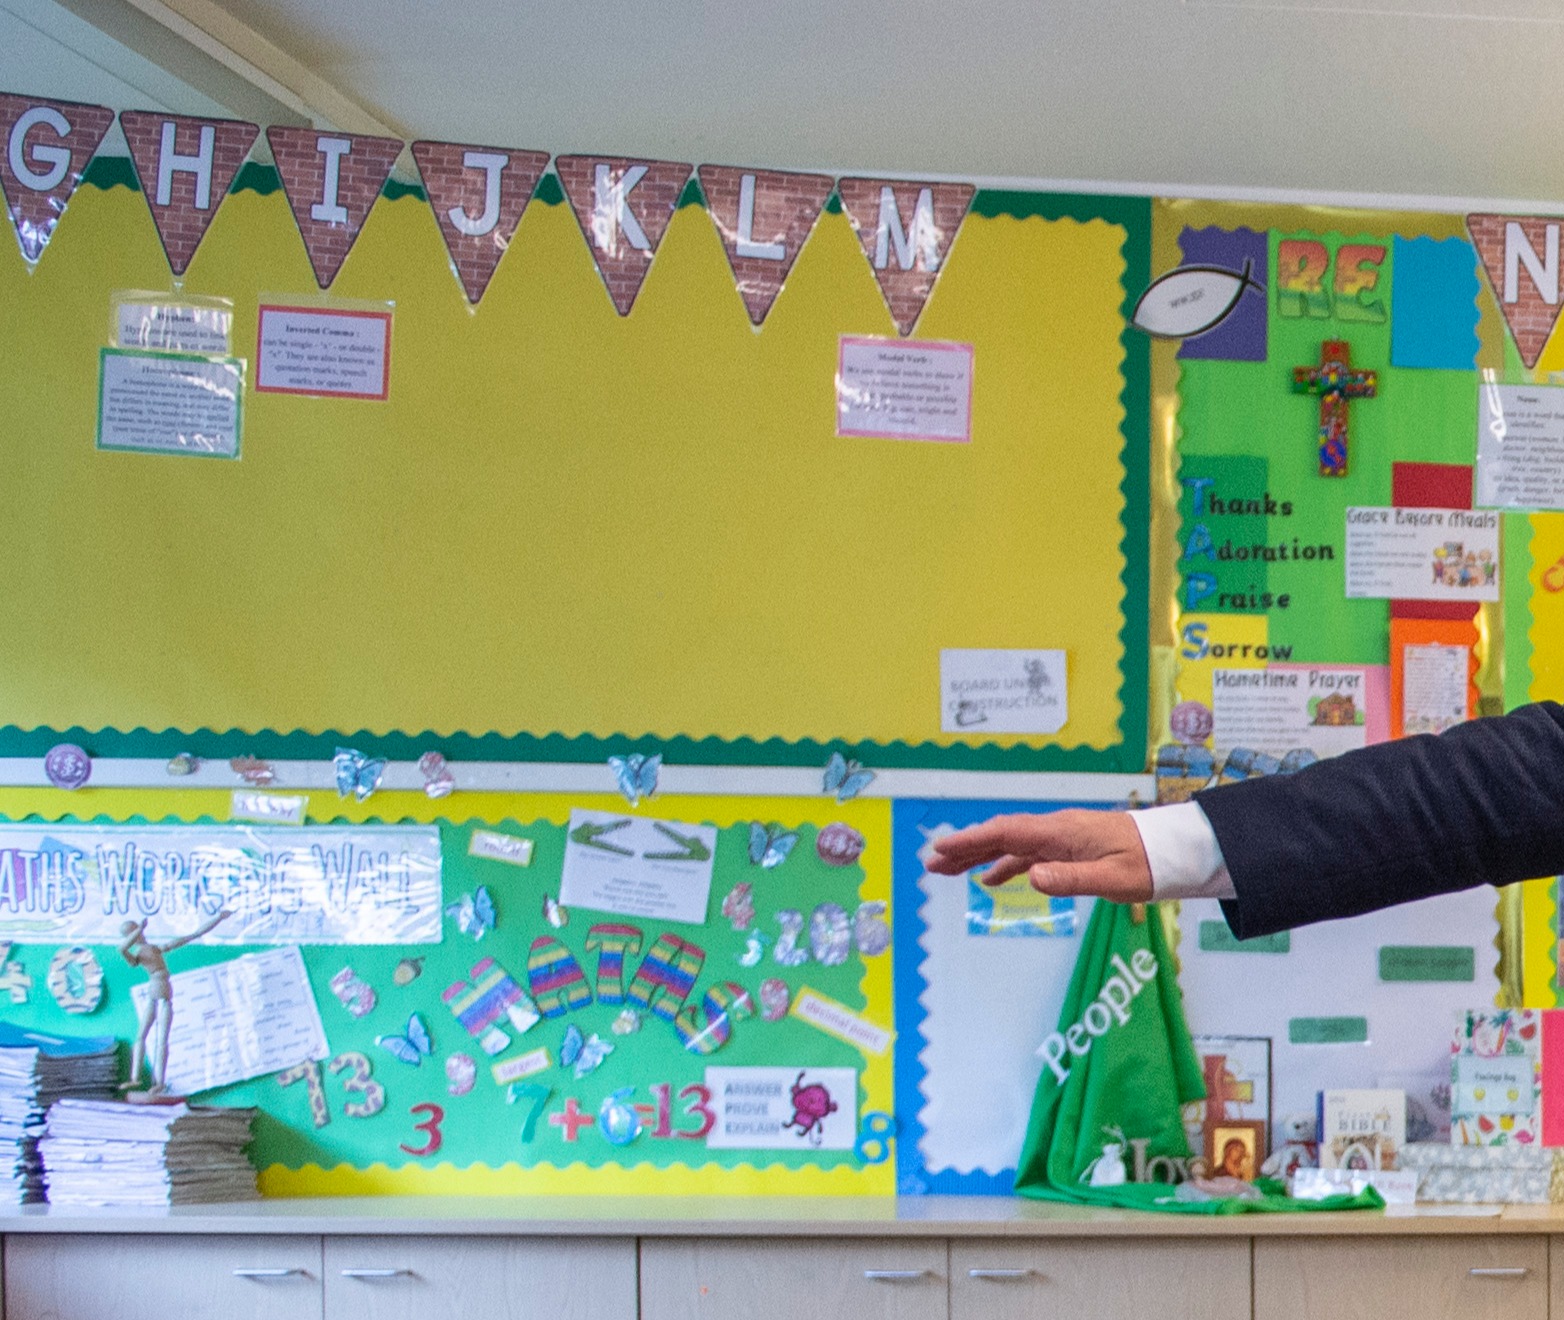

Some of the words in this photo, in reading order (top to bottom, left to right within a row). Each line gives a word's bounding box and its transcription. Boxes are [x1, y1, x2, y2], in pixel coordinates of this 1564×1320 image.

[7, 108, 72, 190] G
[156, 122, 215, 209] H
[311, 138, 350, 224] I
[447, 152, 508, 235] J
[595, 164, 652, 250] K
[736, 175, 786, 260] L
[875, 186, 939, 271] M
[1504, 222, 1559, 304] N
[1278, 240, 1387, 324] RE
[1183, 478, 1293, 517] Thanks
[1183, 524, 1334, 561] Adoration
[1187, 573, 1291, 610] Praise
[1182, 623, 1293, 660] Sorrow
[1308, 671, 1361, 690] Prayer
[0, 849, 85, 913] ATHS
[441, 923, 755, 1056] MATHS
[1034, 947, 1160, 1086] People
[400, 1103, 444, 1156] 3
[855, 1110, 896, 1164] 8
